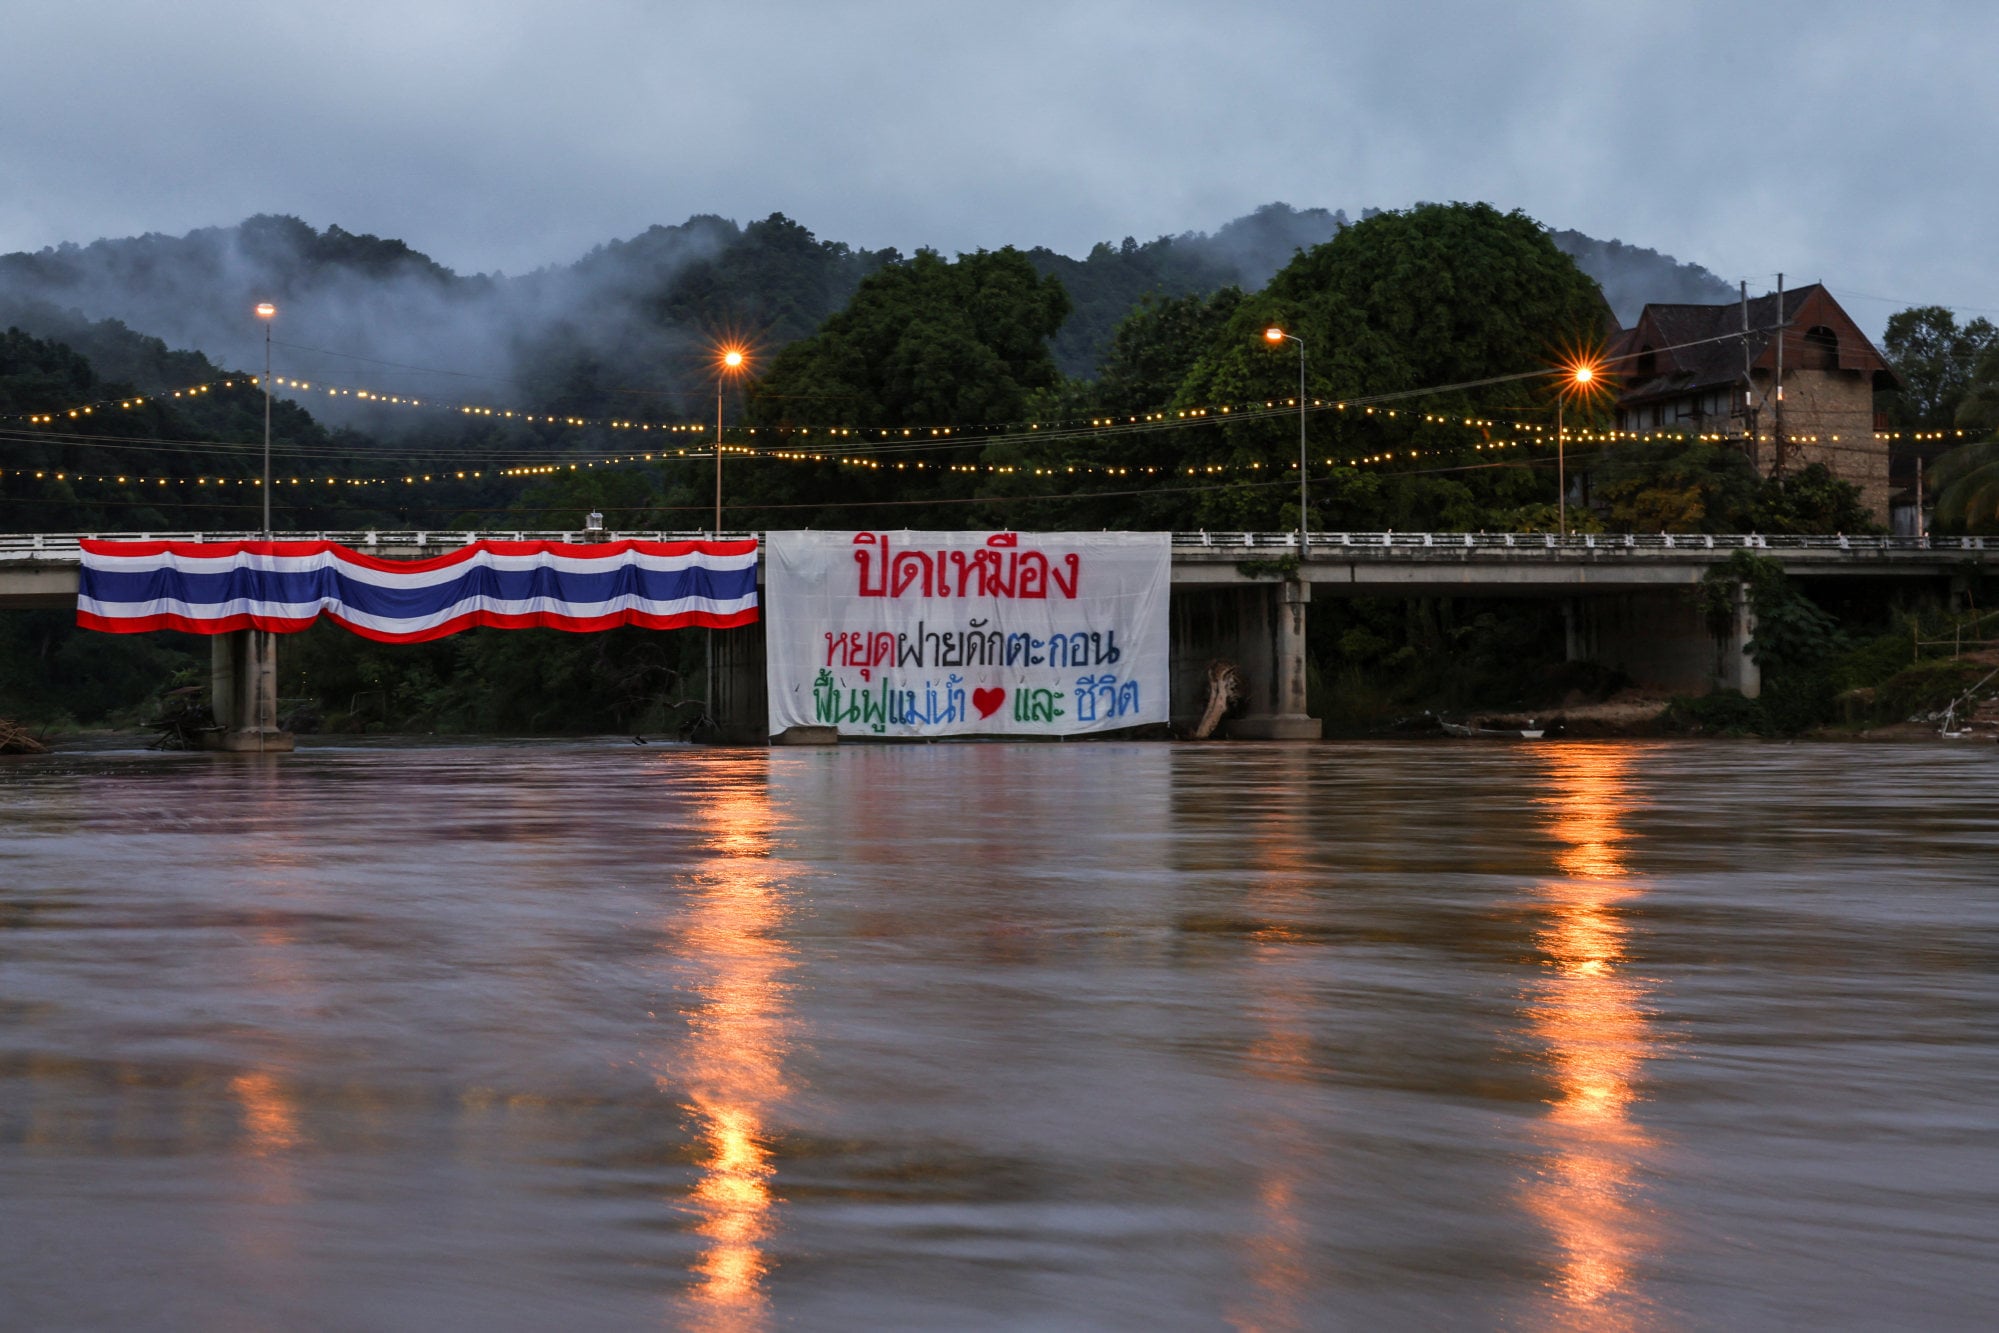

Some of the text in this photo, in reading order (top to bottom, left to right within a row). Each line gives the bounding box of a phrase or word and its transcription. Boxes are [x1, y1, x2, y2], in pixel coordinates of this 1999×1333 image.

[853, 532, 1079, 599] ปิดเหมือง
[825, 618, 1121, 682] หยุดฝายดักตะกอน
[1014, 688, 1065, 722] และ
[1074, 674, 1139, 721] ชีวิต
